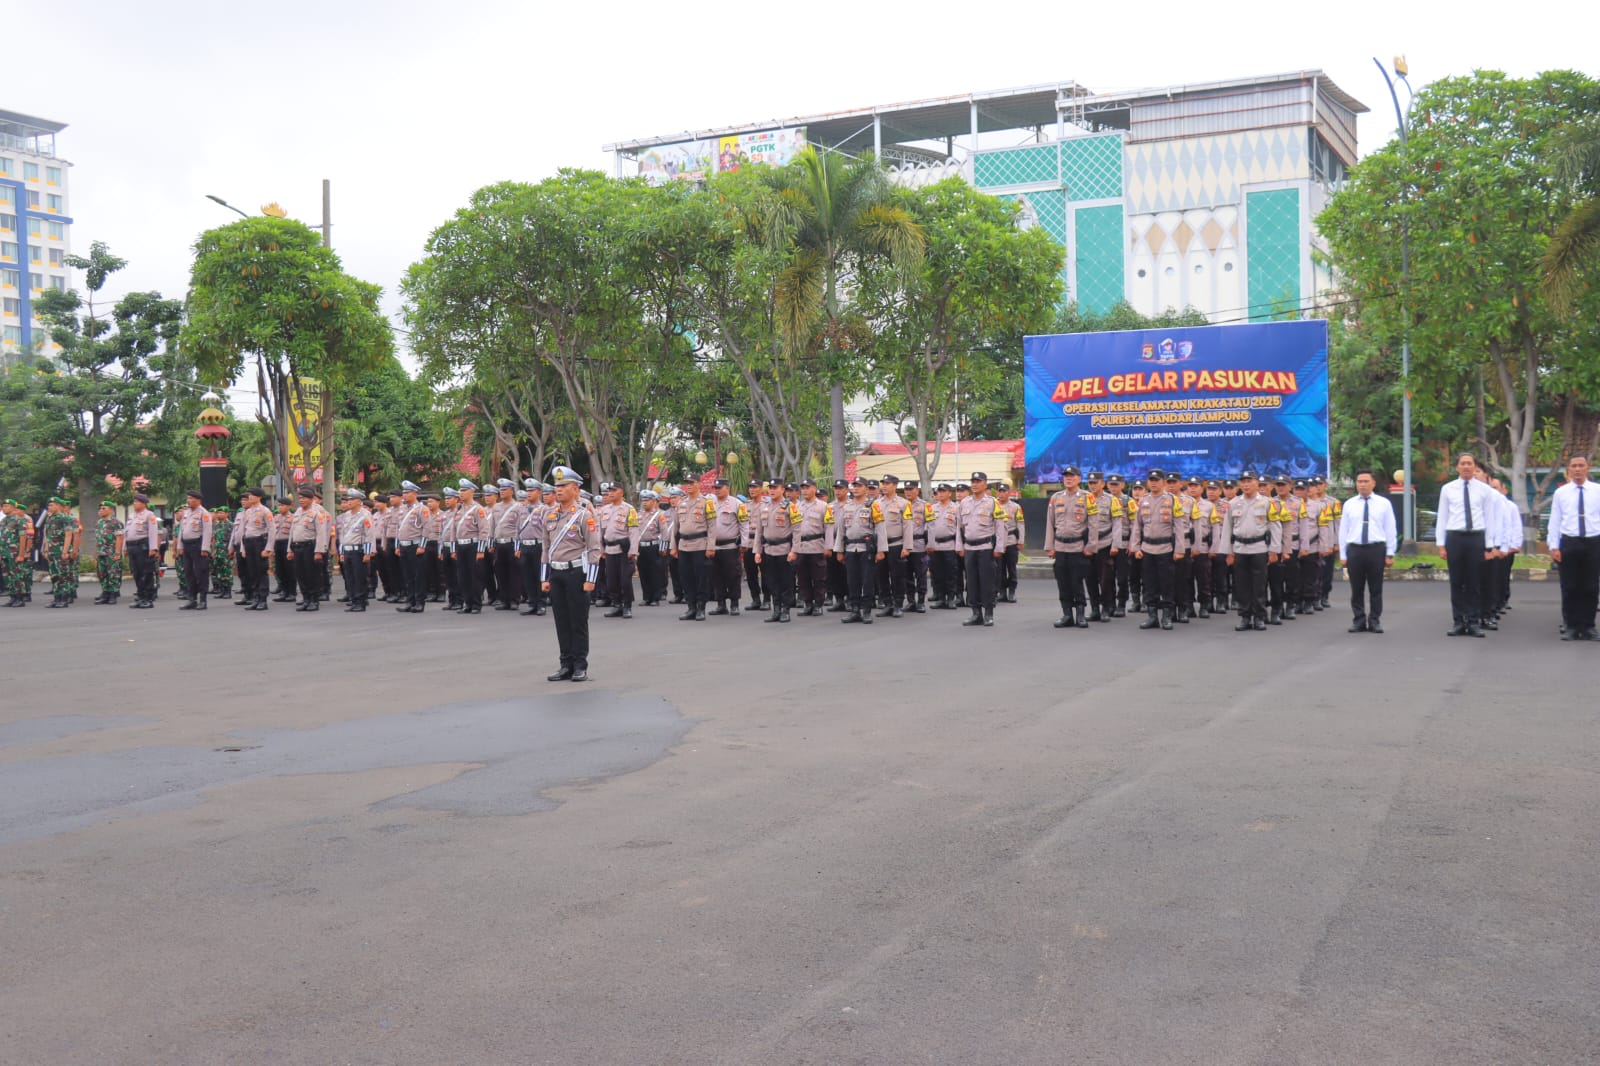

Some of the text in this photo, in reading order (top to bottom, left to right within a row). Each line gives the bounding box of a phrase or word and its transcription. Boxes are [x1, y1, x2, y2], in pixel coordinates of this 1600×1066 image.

[1051, 370, 1297, 400] APEL GELAR PASUKAN
[1064, 396, 1280, 414] OPERASI KESELAMATAN KRAKATAU 2025
[1092, 410, 1250, 425] POLRESTA BANDAR LAMPUNG
[1174, 430, 1224, 438] TERWUJUDNYA
